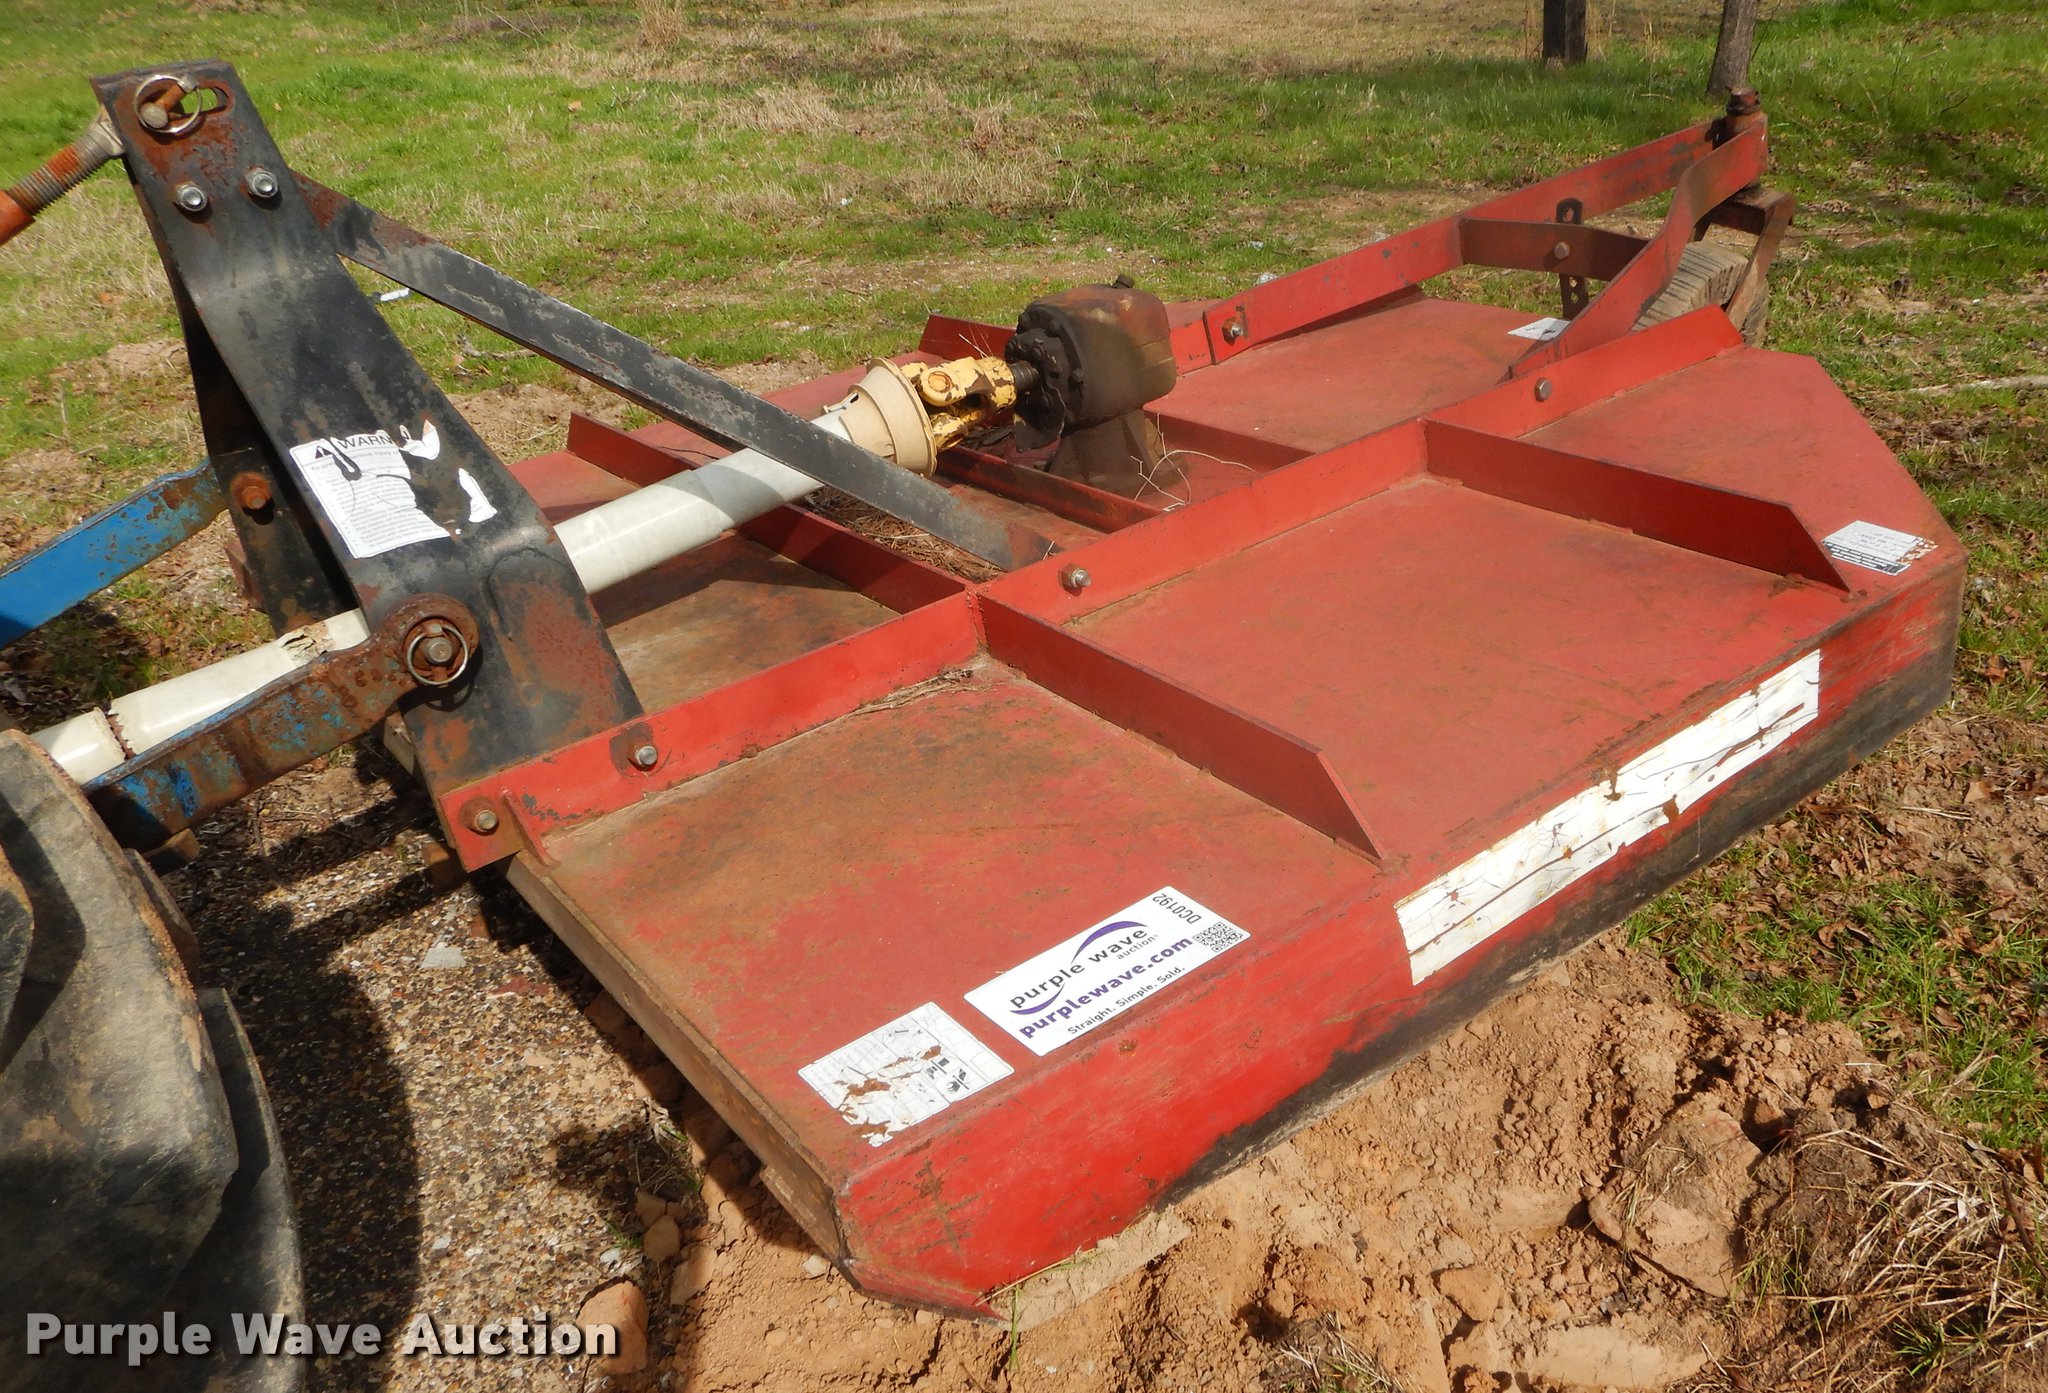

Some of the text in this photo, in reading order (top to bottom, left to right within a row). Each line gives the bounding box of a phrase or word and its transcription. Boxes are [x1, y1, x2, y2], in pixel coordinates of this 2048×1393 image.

[338, 434, 398, 449] WARN
[1152, 893, 1202, 924] DC0192
[1010, 929, 1148, 1008] purple wave
[1117, 935, 1156, 960] auction
[1019, 938, 1192, 1038] purplewave.com
[1067, 967, 1186, 1034] Straight. Simple. Sold.
